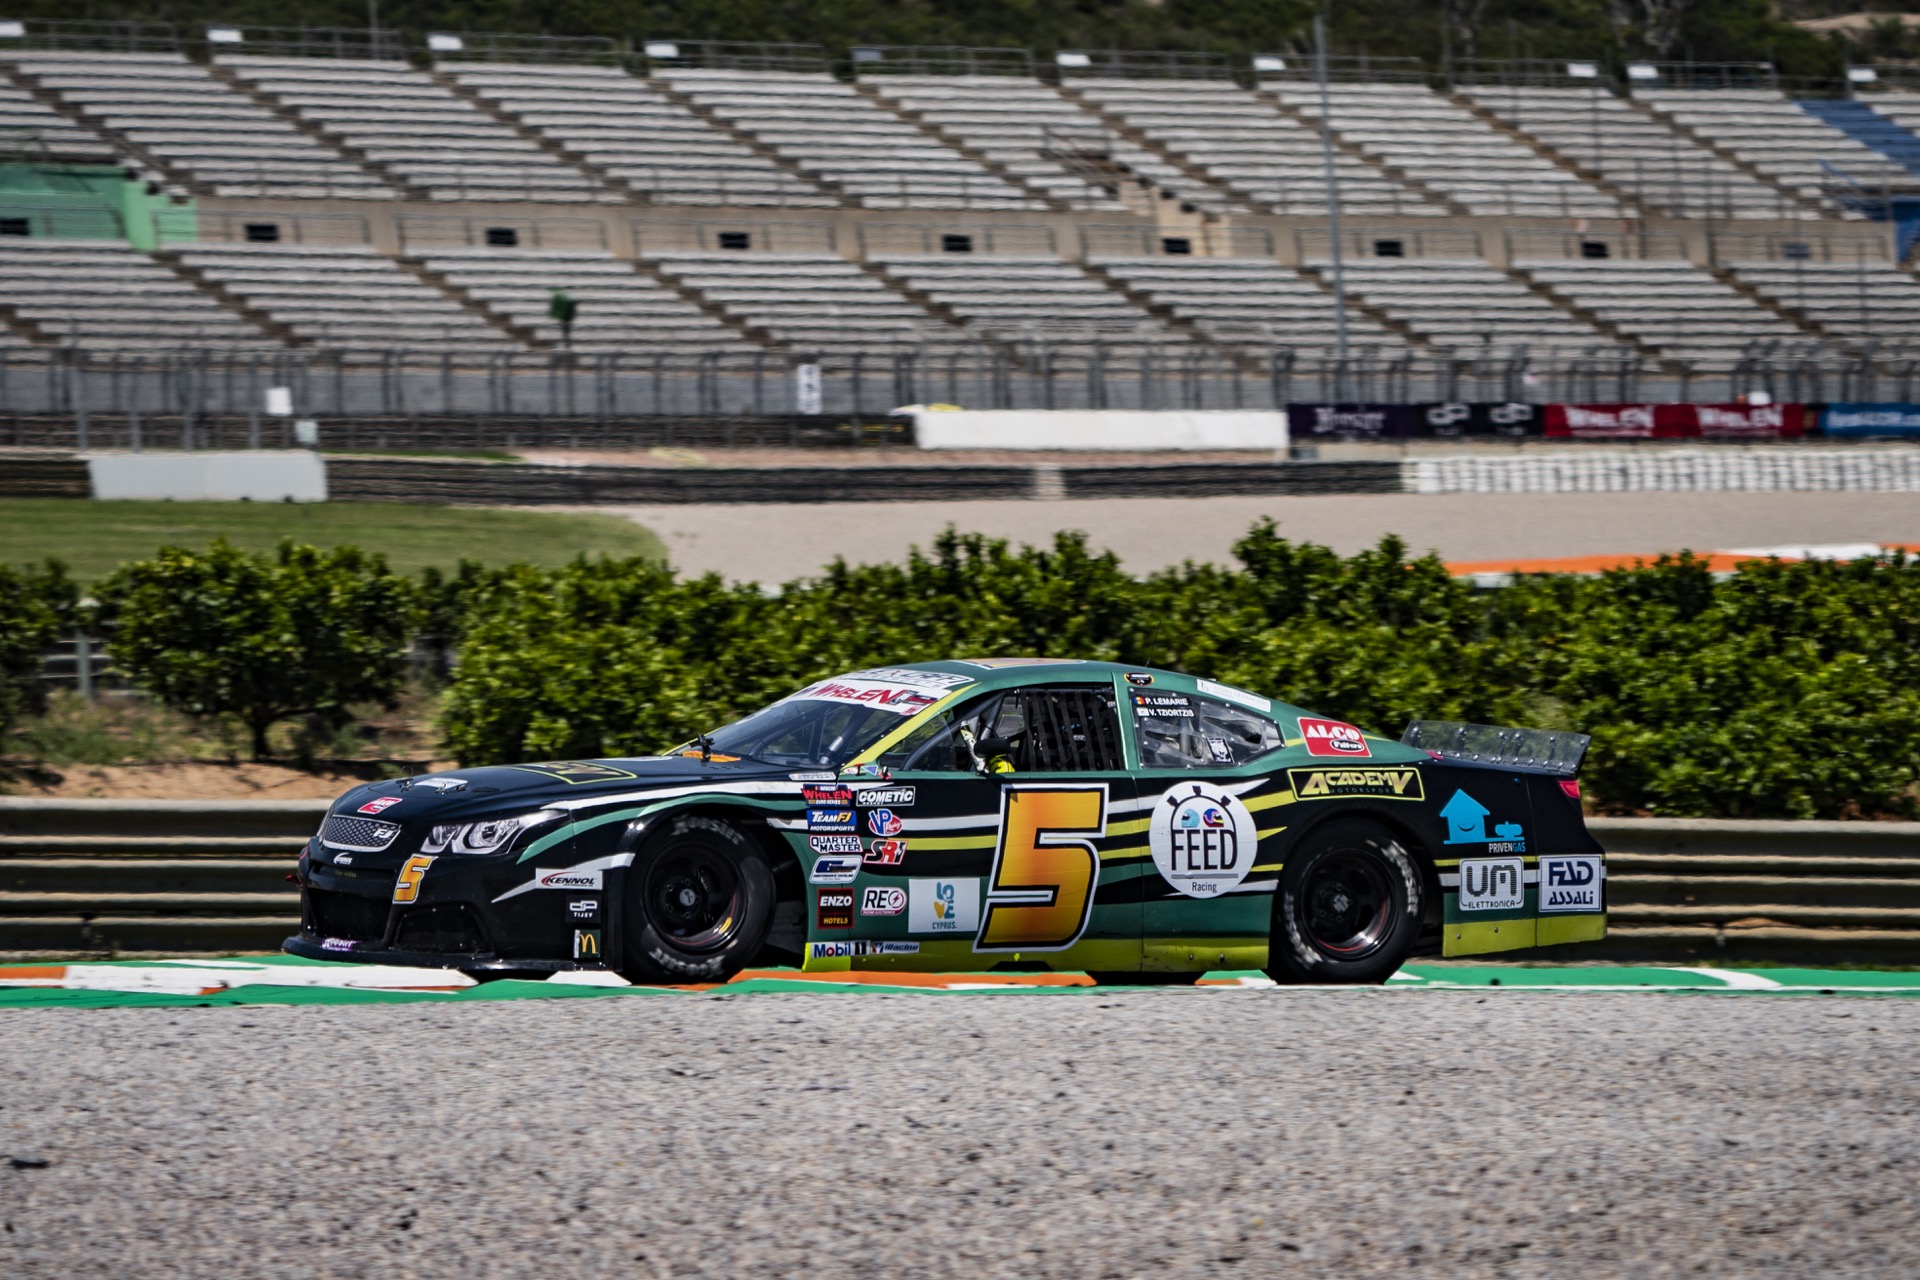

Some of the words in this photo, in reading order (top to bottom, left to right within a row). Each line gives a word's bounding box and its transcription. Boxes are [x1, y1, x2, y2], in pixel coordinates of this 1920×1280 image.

[812, 684, 907, 704] WHELEN
[1156, 709, 1194, 717] TZIORTZIS
[1307, 725, 1360, 740] ALCO
[1333, 741, 1362, 749] Filters
[1301, 772, 1414, 795] ACADEMY
[801, 788, 852, 800] WHELEN
[859, 789, 913, 803] COMETIC
[869, 809, 892, 834] VP
[812, 837, 858, 847] QUARTER
[820, 844, 860, 852] MASTER
[1488, 843, 1526, 853] PRIVENGAS
[1171, 829, 1238, 870] FEED
[973, 783, 1109, 953] 5
[1548, 861, 1594, 886] FAD
[392, 853, 439, 904] 5
[545, 877, 595, 885] KENNOL
[1466, 865, 1518, 897] UM
[1192, 882, 1217, 893] Racing
[820, 896, 852, 907] ENZO
[1468, 900, 1516, 909] ELETTRONICA
[814, 943, 851, 958] Mobil
